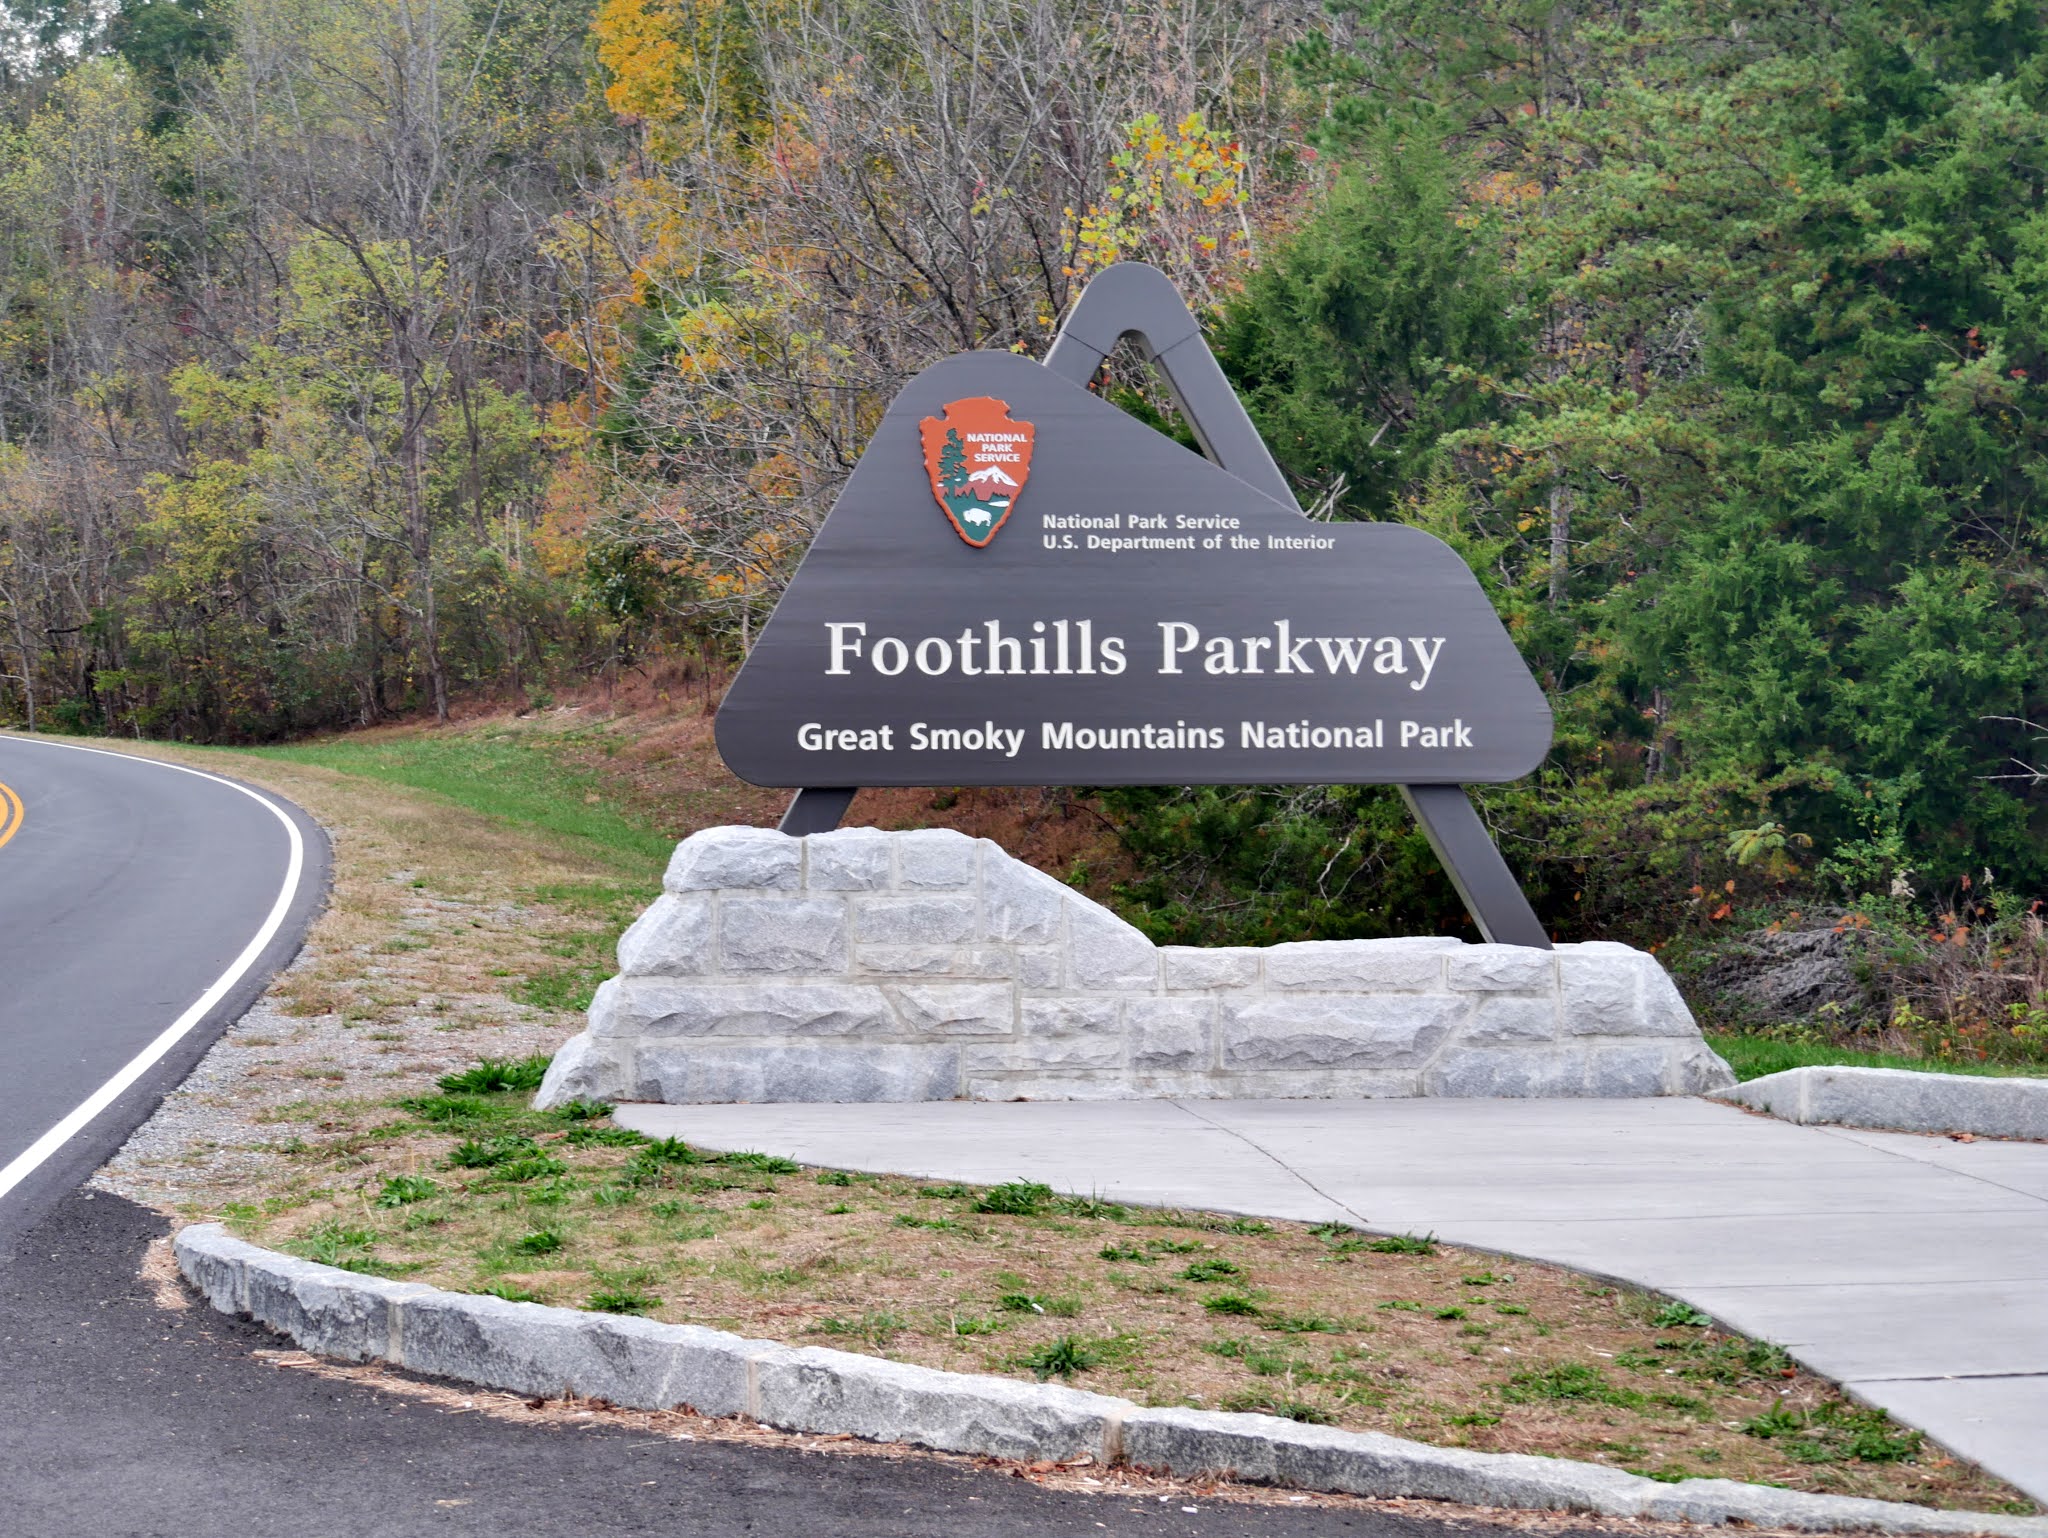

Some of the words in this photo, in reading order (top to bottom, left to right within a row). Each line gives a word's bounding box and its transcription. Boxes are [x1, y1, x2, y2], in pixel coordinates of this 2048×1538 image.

[966, 433, 1028, 443] NATIONAL
[981, 443, 1013, 452] PARK
[973, 453, 1021, 463] SERVICE
[1042, 513, 1120, 529] National
[1128, 513, 1168, 529] Park
[1175, 514, 1240, 529] Service
[1042, 535, 1079, 550] U.S.
[1087, 535, 1195, 552] Department
[1202, 534, 1223, 550] of
[1229, 534, 1261, 550] the
[1267, 534, 1336, 550] Interior
[824, 618, 1127, 677] Foothills
[1157, 618, 1449, 692] Parkway
[797, 722, 895, 752] Great
[909, 720, 1026, 758] Smoky
[1041, 719, 1225, 750] Mountains
[1240, 718, 1384, 750] National
[1399, 718, 1475, 749] Park
